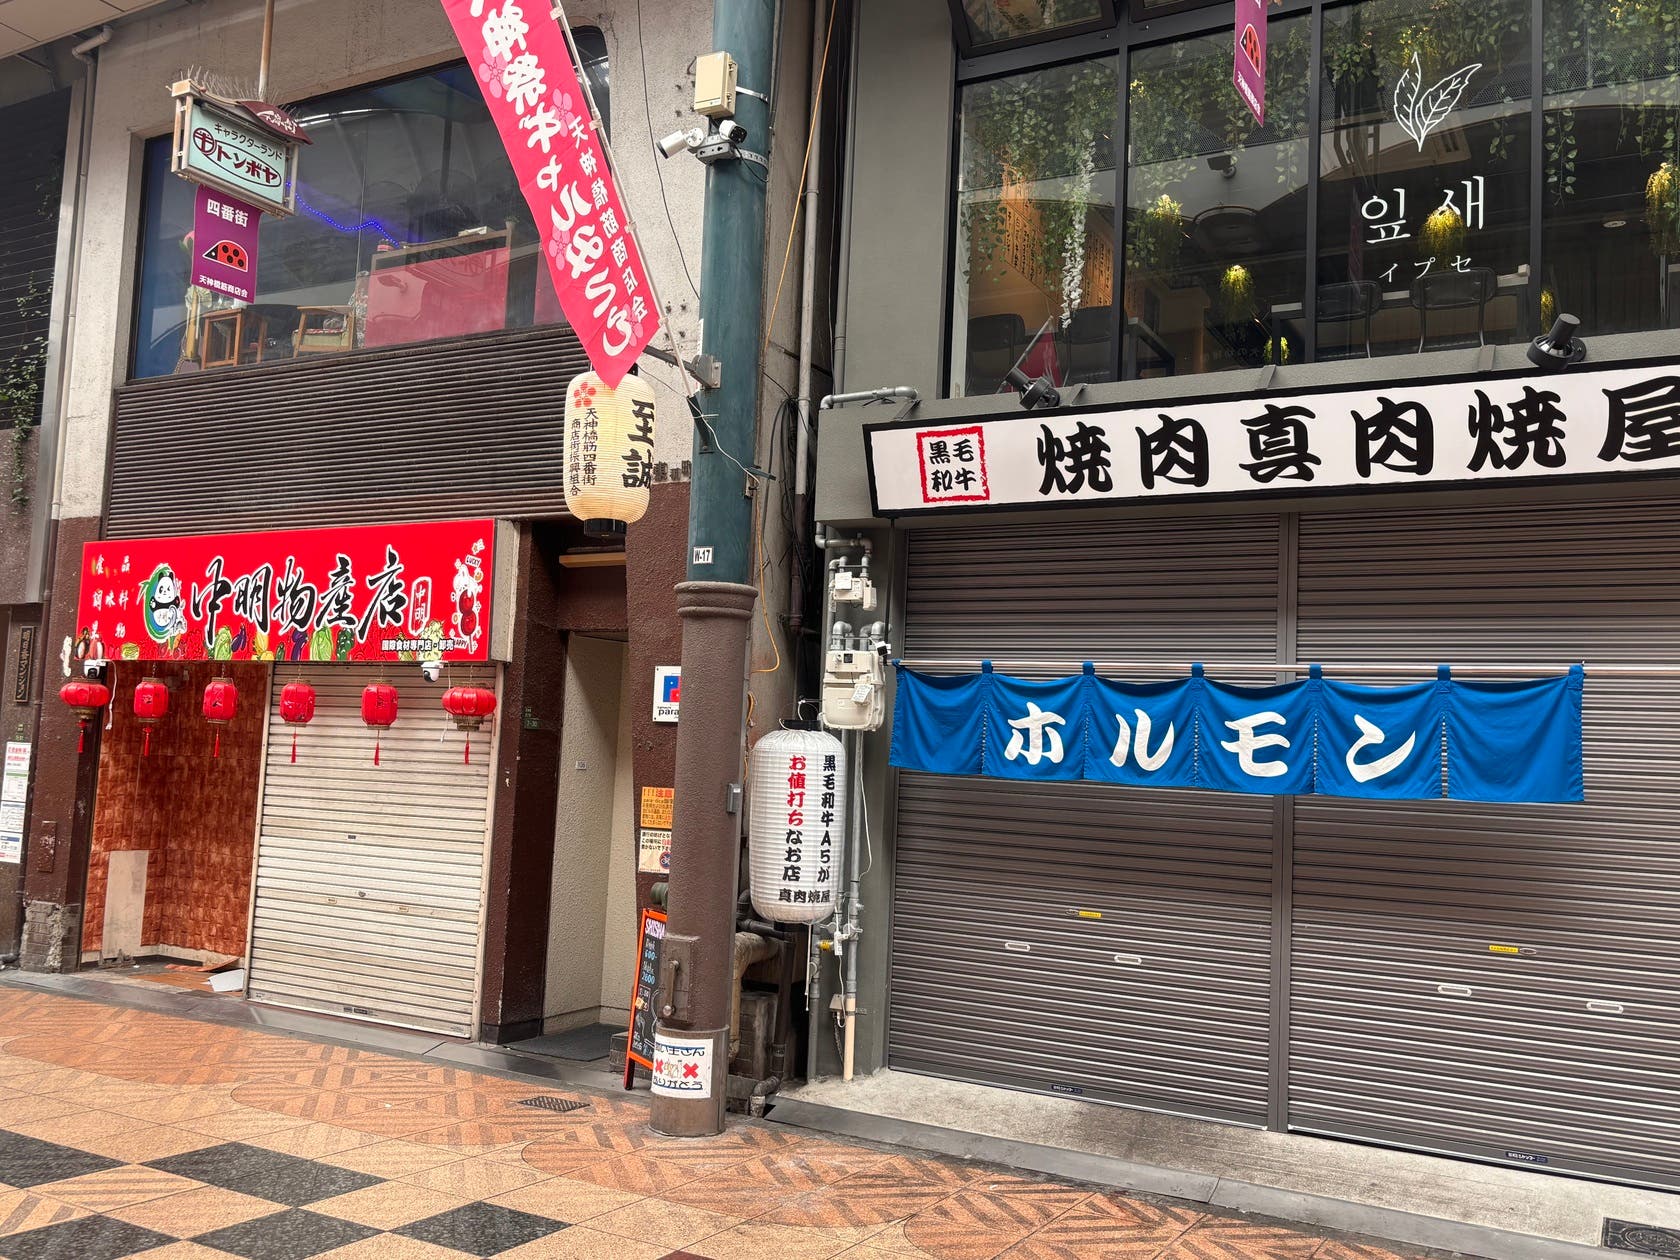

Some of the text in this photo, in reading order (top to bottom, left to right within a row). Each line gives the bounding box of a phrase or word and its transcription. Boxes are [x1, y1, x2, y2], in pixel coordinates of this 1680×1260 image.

[214, 122, 283, 161] キャラクターランド
[216, 143, 278, 185] トンボヤ
[206, 198, 248, 228] 四番街
[1361, 175, 1484, 243] 잎새
[1378, 255, 1472, 283] イプセ
[582, 407, 599, 486] 天神橋筋四番街
[621, 398, 655, 489] 至誠
[928, 438, 974, 464] 黒毛
[1037, 375, 1680, 495] 焼肉真肉焼屋
[931, 468, 977, 492] 和牛
[1004, 702, 1416, 784] ホルモン
[782, 754, 807, 882] お値打ちなお店
[778, 888, 831, 904] 真肉焼屋
